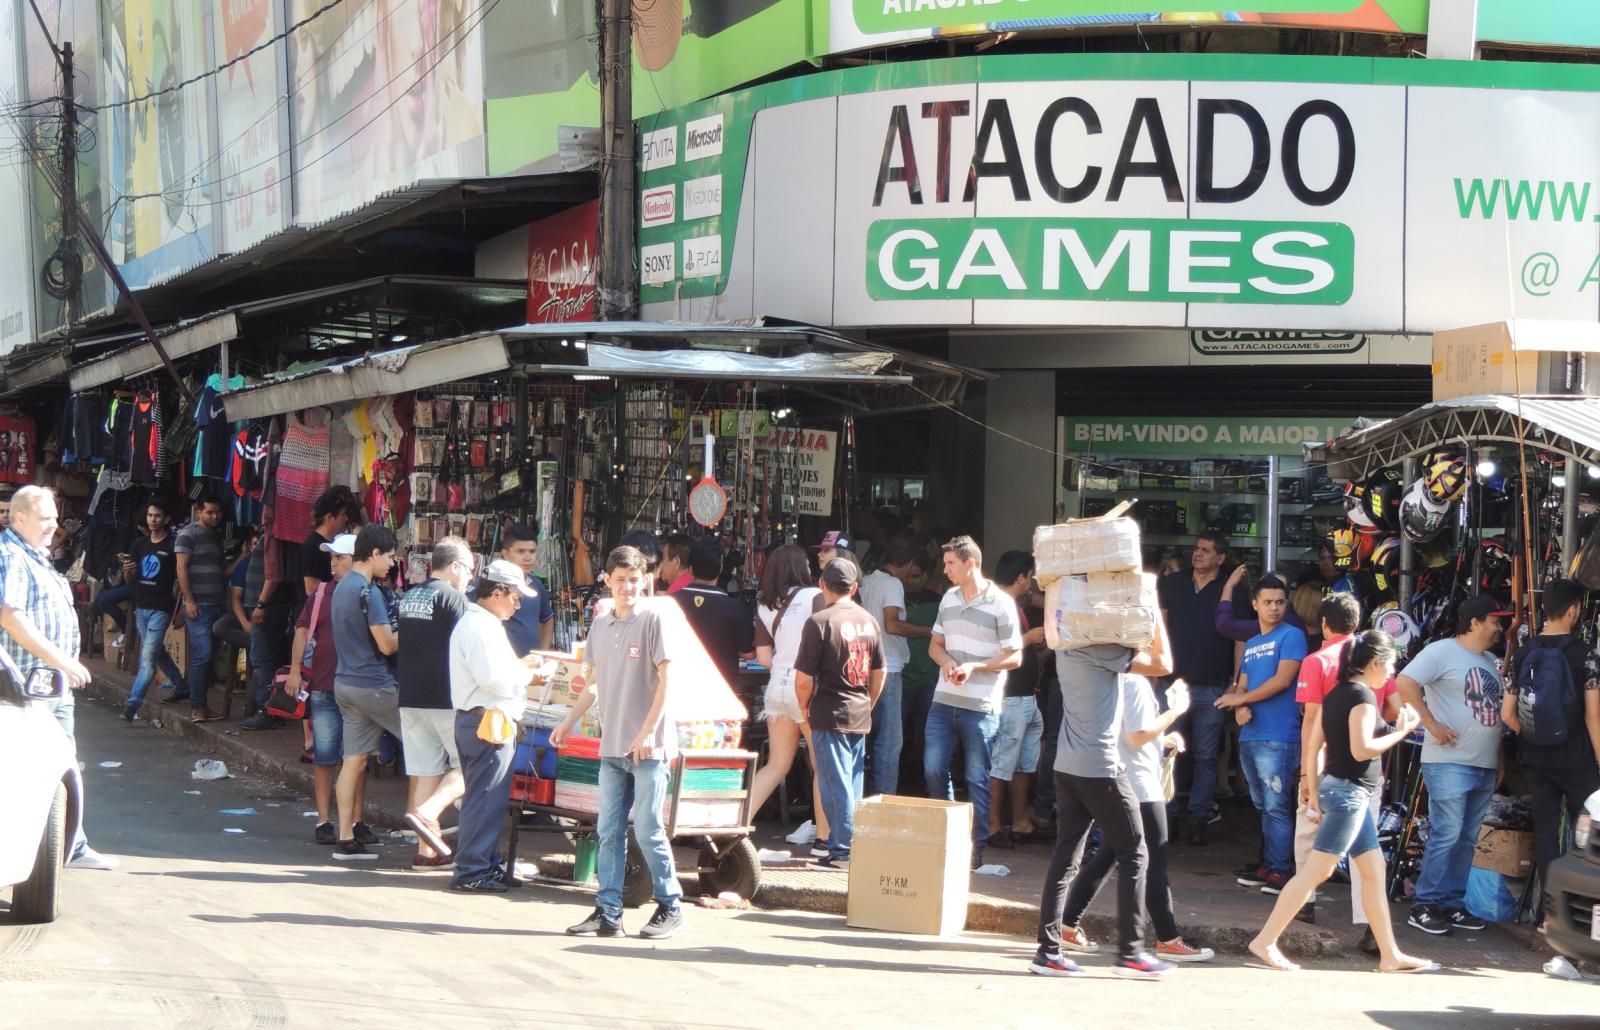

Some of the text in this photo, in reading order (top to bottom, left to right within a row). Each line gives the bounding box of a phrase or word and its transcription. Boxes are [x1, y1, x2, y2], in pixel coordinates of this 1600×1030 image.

[686, 123, 722, 151] Microsoft
[872, 96, 1356, 206] ATACADO
[644, 199, 671, 216] Nintendo
[547, 239, 595, 298] CASA
[644, 254, 672, 274] SONY
[696, 250, 720, 268] PS4
[878, 229, 1335, 294] GAMES
[1074, 423, 1209, 443] BEM-VINDO
[1214, 424, 1233, 444] A
[1239, 424, 1320, 445] MAIOR
[1334, 557, 1351, 566] 46
[879, 875, 908, 889] PY-KM
